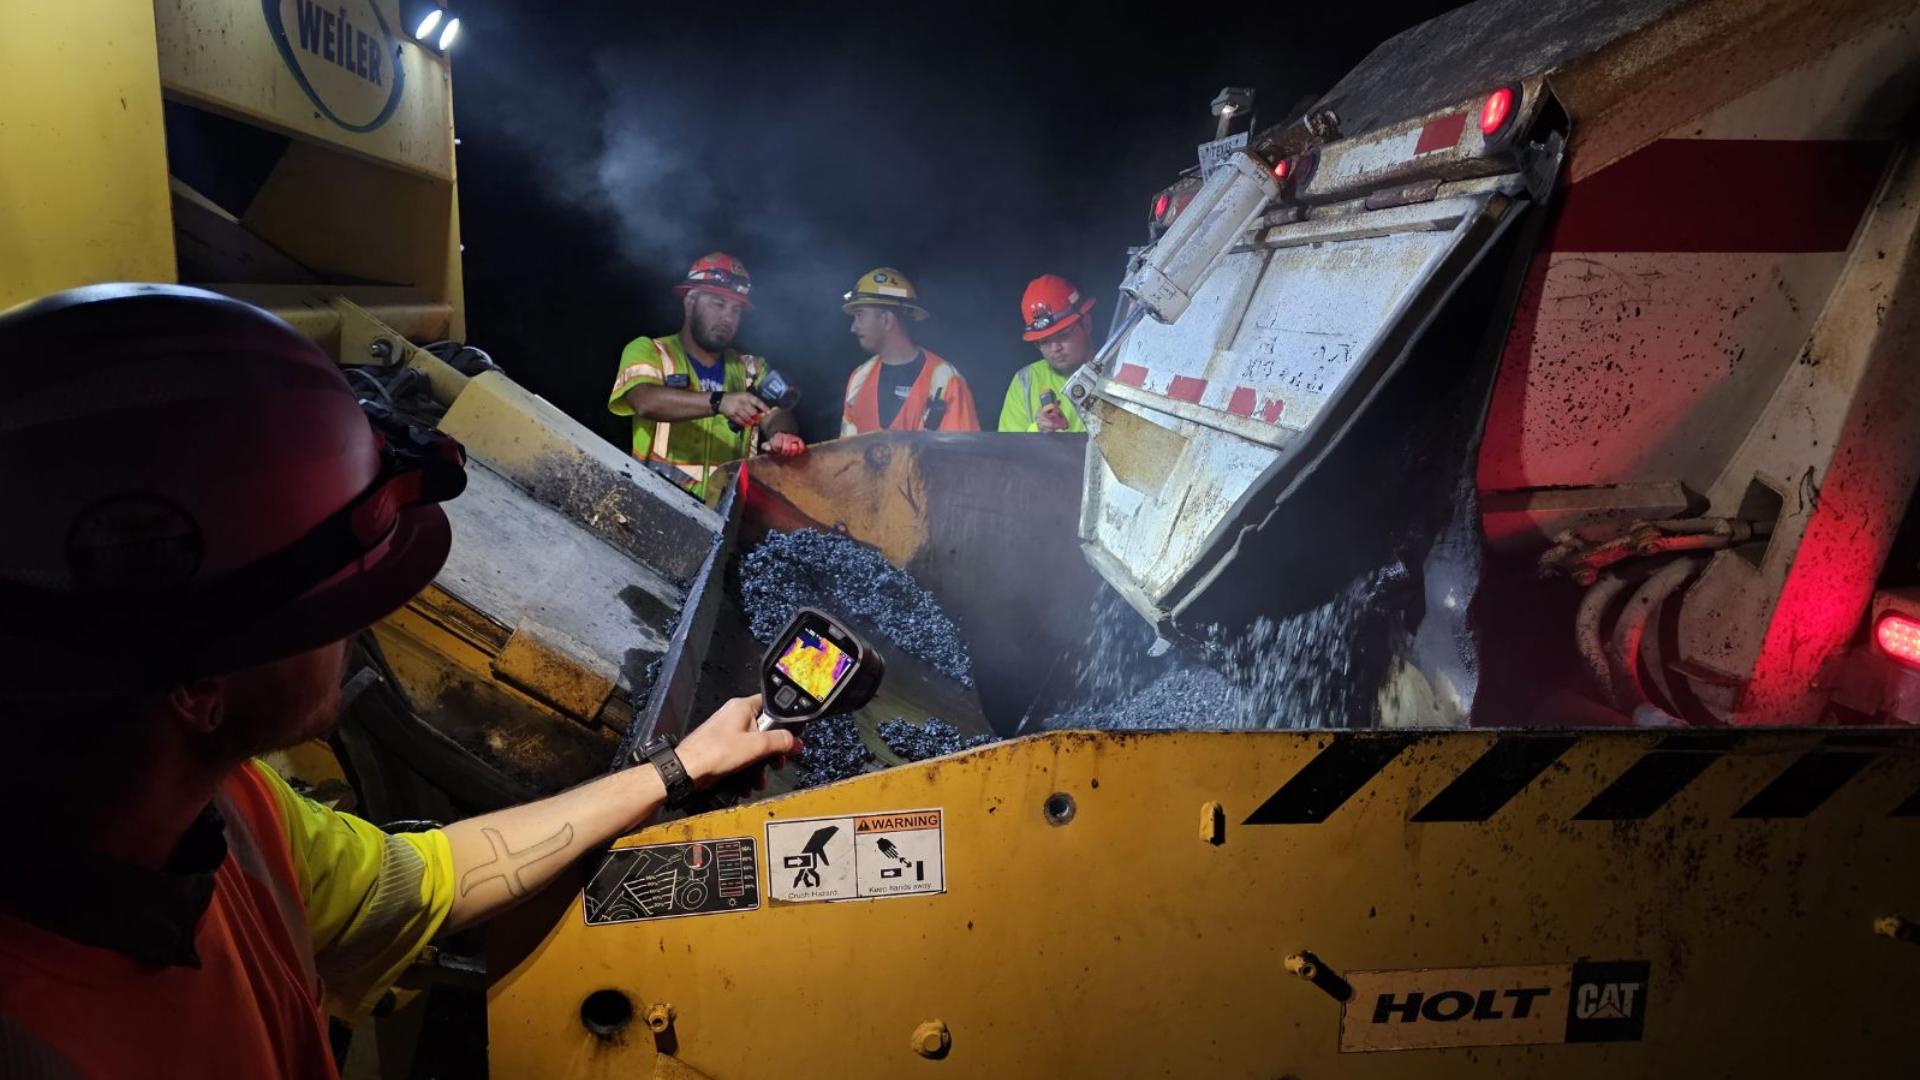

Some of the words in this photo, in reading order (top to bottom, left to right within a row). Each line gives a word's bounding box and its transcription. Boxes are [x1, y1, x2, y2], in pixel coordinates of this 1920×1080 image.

[871, 814, 939, 831] WARNING
[1371, 987, 1552, 1024] HOLT
[1576, 982, 1640, 1020] CAT
